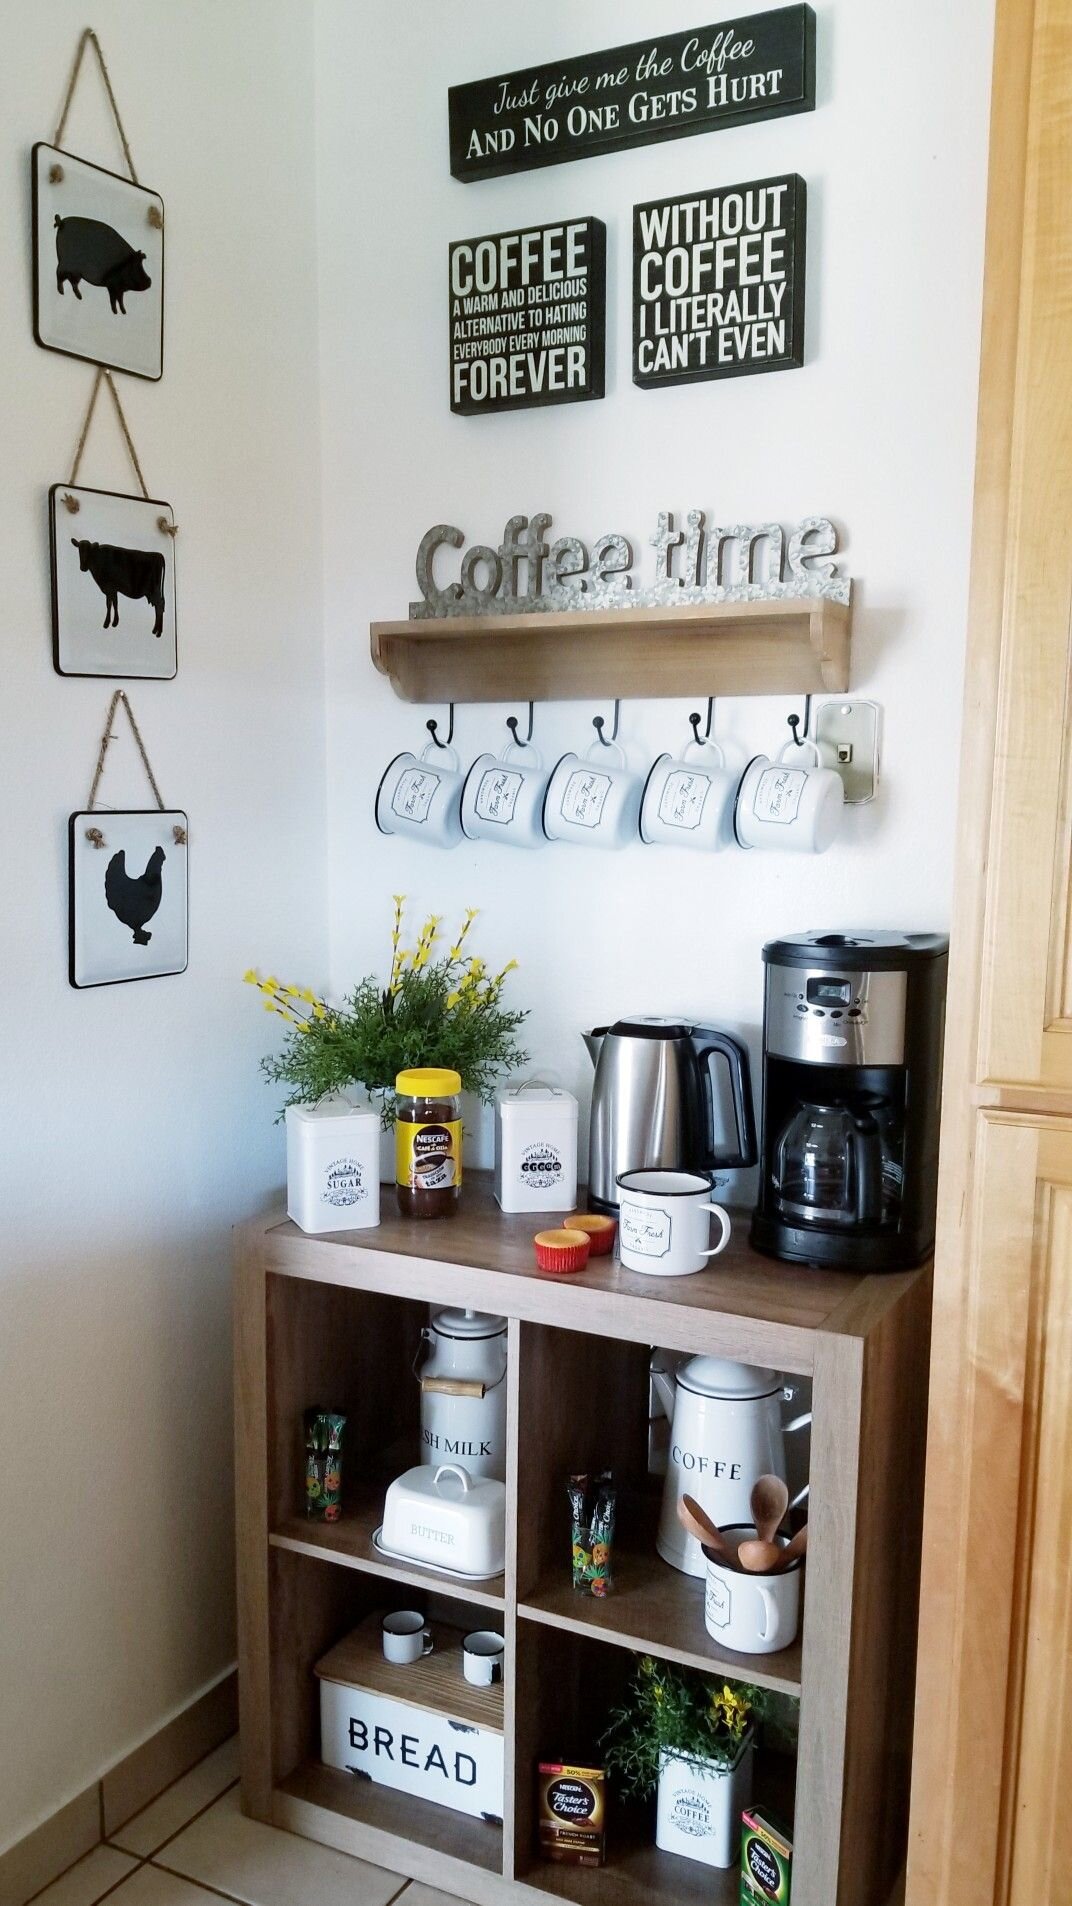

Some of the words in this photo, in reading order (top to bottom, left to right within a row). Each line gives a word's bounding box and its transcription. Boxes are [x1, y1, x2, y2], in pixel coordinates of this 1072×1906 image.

[494, 82, 540, 115] Just
[546, 77, 589, 110] give
[597, 69, 629, 88] me
[636, 48, 673, 80] the
[681, 29, 755, 75] Coffee
[465, 128, 514, 160] AND
[640, 184, 788, 251] WITHOUT
[451, 222, 588, 297] COFFEE
[640, 228, 786, 301] COFFEE
[453, 298, 462, 317] A
[463, 289, 499, 316] WARM
[501, 288, 525, 311] AND
[528, 278, 587, 305] DELICIOUS
[639, 304, 646, 338] I
[654, 282, 787, 335] LITERALLY
[453, 307, 525, 340] ALTERNATIVE
[529, 307, 543, 327] TO
[546, 301, 587, 324] HATING
[453, 337, 506, 361] EVERYBODY
[509, 330, 539, 353] EVERY
[542, 324, 586, 349] MORNING
[638, 331, 711, 374] CAN'T
[717, 320, 786, 363] EVEN
[453, 345, 586, 403] FOREVER
[415, 513, 634, 601] Coffee
[649, 509, 839, 587] time
[327, 1178, 362, 1190] SUGAR
[445, 1438, 493, 1456] MILK
[672, 1446, 742, 1481] COFFE
[411, 1524, 456, 1545] BUTTER
[348, 1717, 477, 1786] BREAD
[552, 1791, 590, 1806] Taster's
[553, 1802, 588, 1815] Choice
[674, 1805, 710, 1823] COFFEE
[750, 1847, 777, 1878] Taster's
[750, 1860, 776, 1887] Choice
